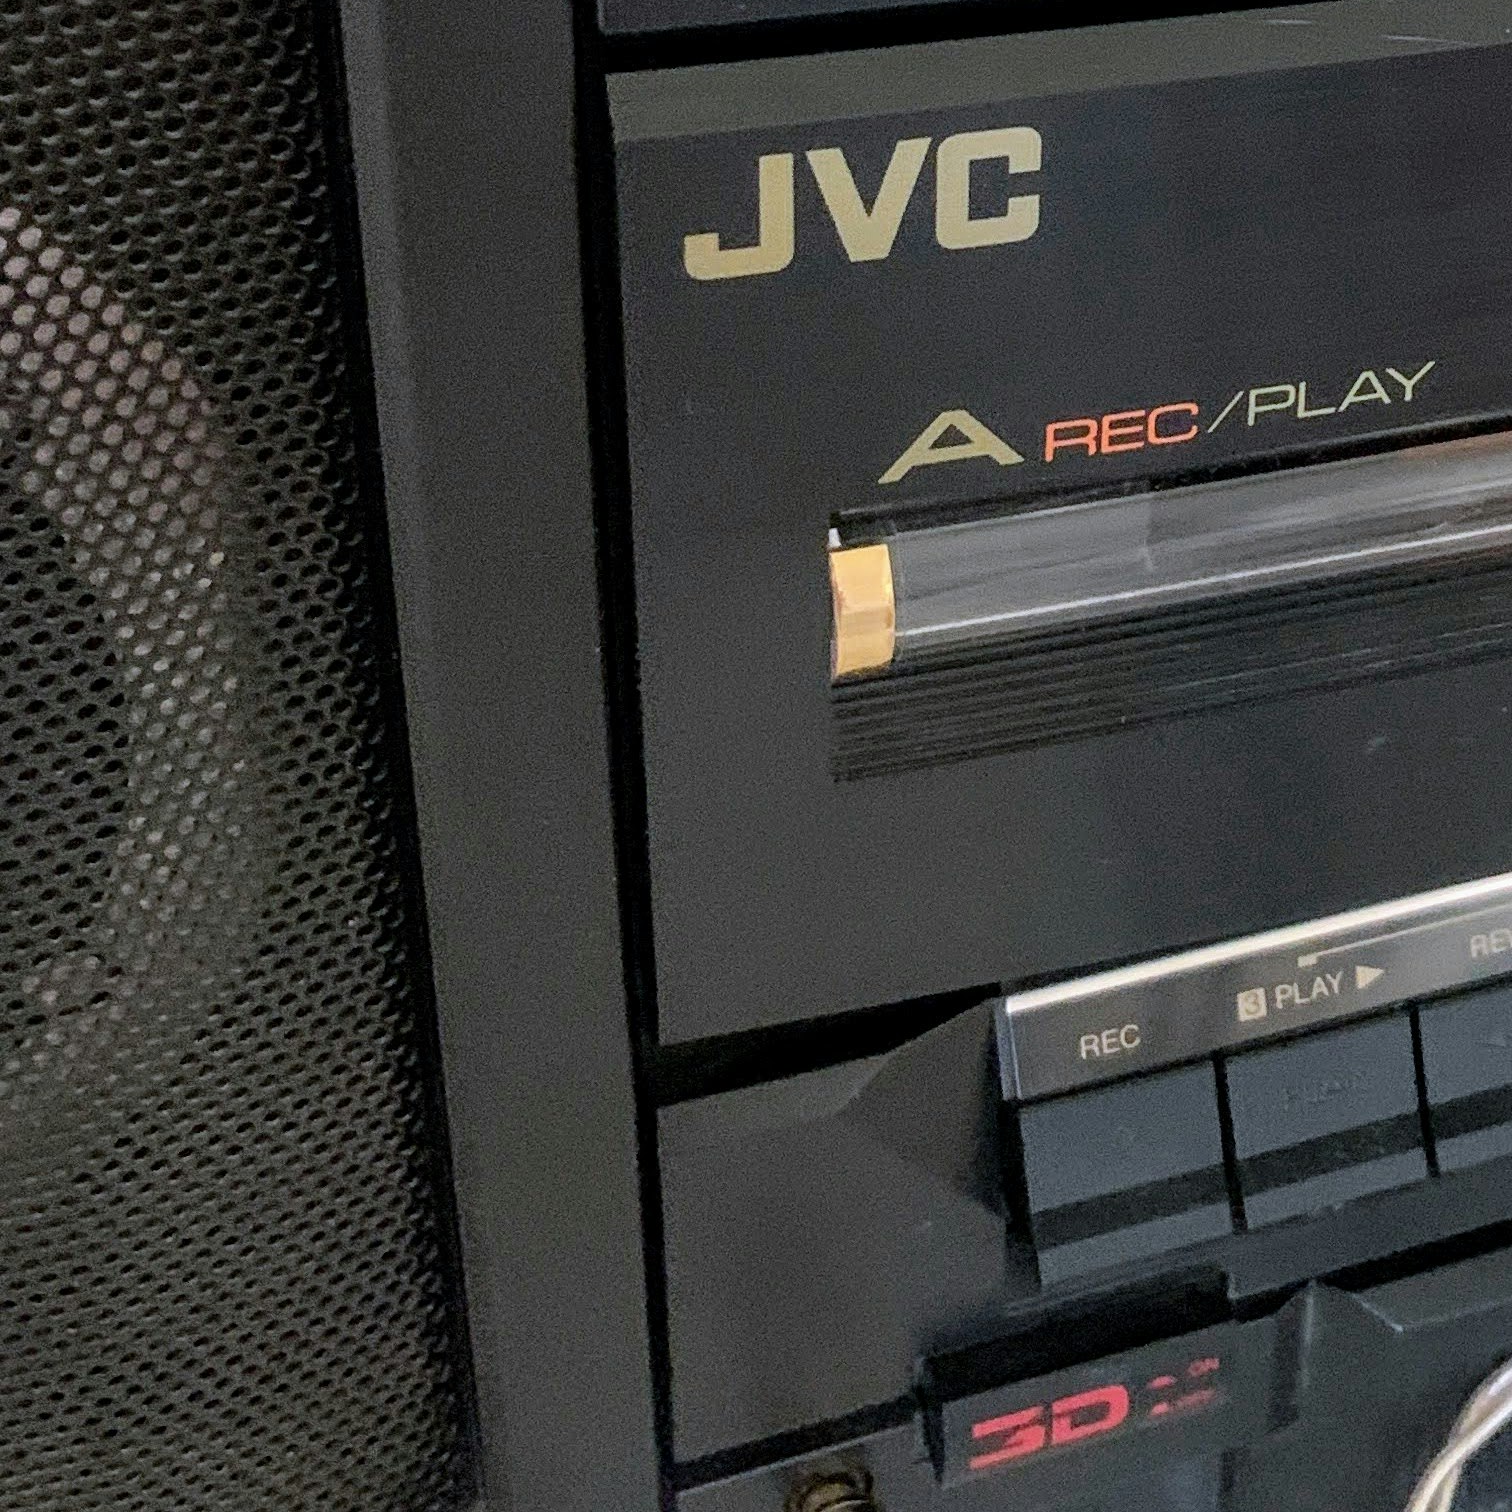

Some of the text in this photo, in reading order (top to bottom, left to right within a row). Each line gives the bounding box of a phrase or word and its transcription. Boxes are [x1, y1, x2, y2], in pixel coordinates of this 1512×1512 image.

[682, 125, 1042, 282] JVC
[876, 409, 1025, 485] A
[1275, 971, 1344, 1009] PLAY
[1079, 1024, 1141, 1060] REC
[968, 1383, 1130, 1471] 3D
